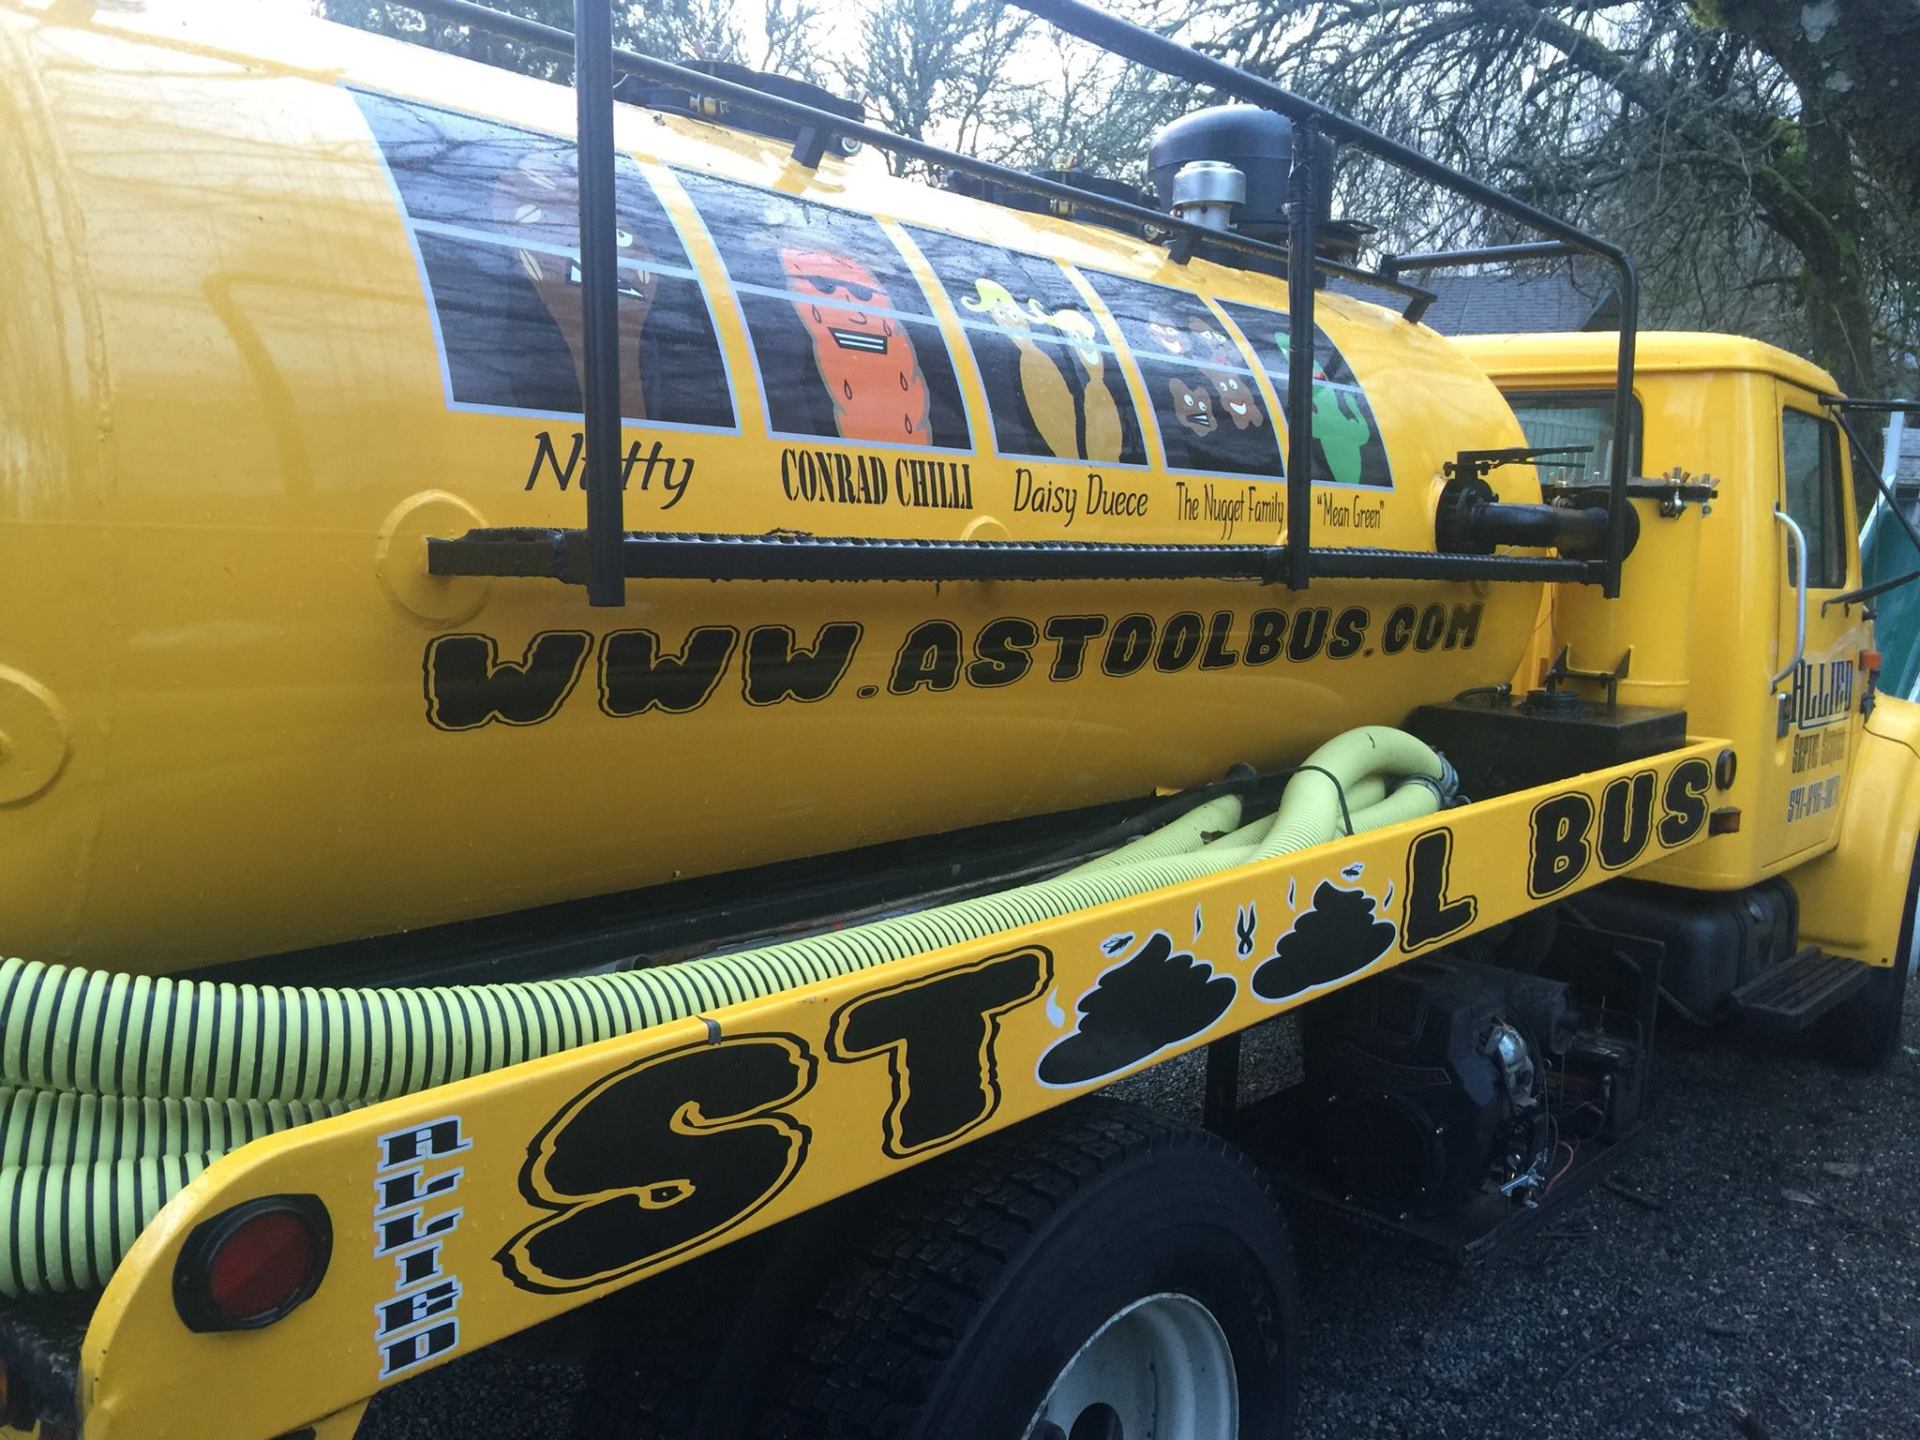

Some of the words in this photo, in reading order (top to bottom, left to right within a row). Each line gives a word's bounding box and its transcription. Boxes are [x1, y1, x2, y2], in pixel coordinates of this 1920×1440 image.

[525, 432, 695, 510] Ntty
[780, 448, 888, 506] CONRAD
[895, 457, 974, 510] CHILLI
[1013, 468, 1078, 527] Daisy
[1086, 473, 1149, 517] Duece
[1176, 481, 1200, 522] The
[1204, 483, 1245, 540] Nugget
[1247, 486, 1285, 526] Family
[424, 600, 1485, 732] WWW.ASTOOLBUS.COM
[1790, 659, 1854, 730] ALLIED
[1527, 757, 1713, 901] BUS
[373, 1114, 474, 1381] ALLIED
